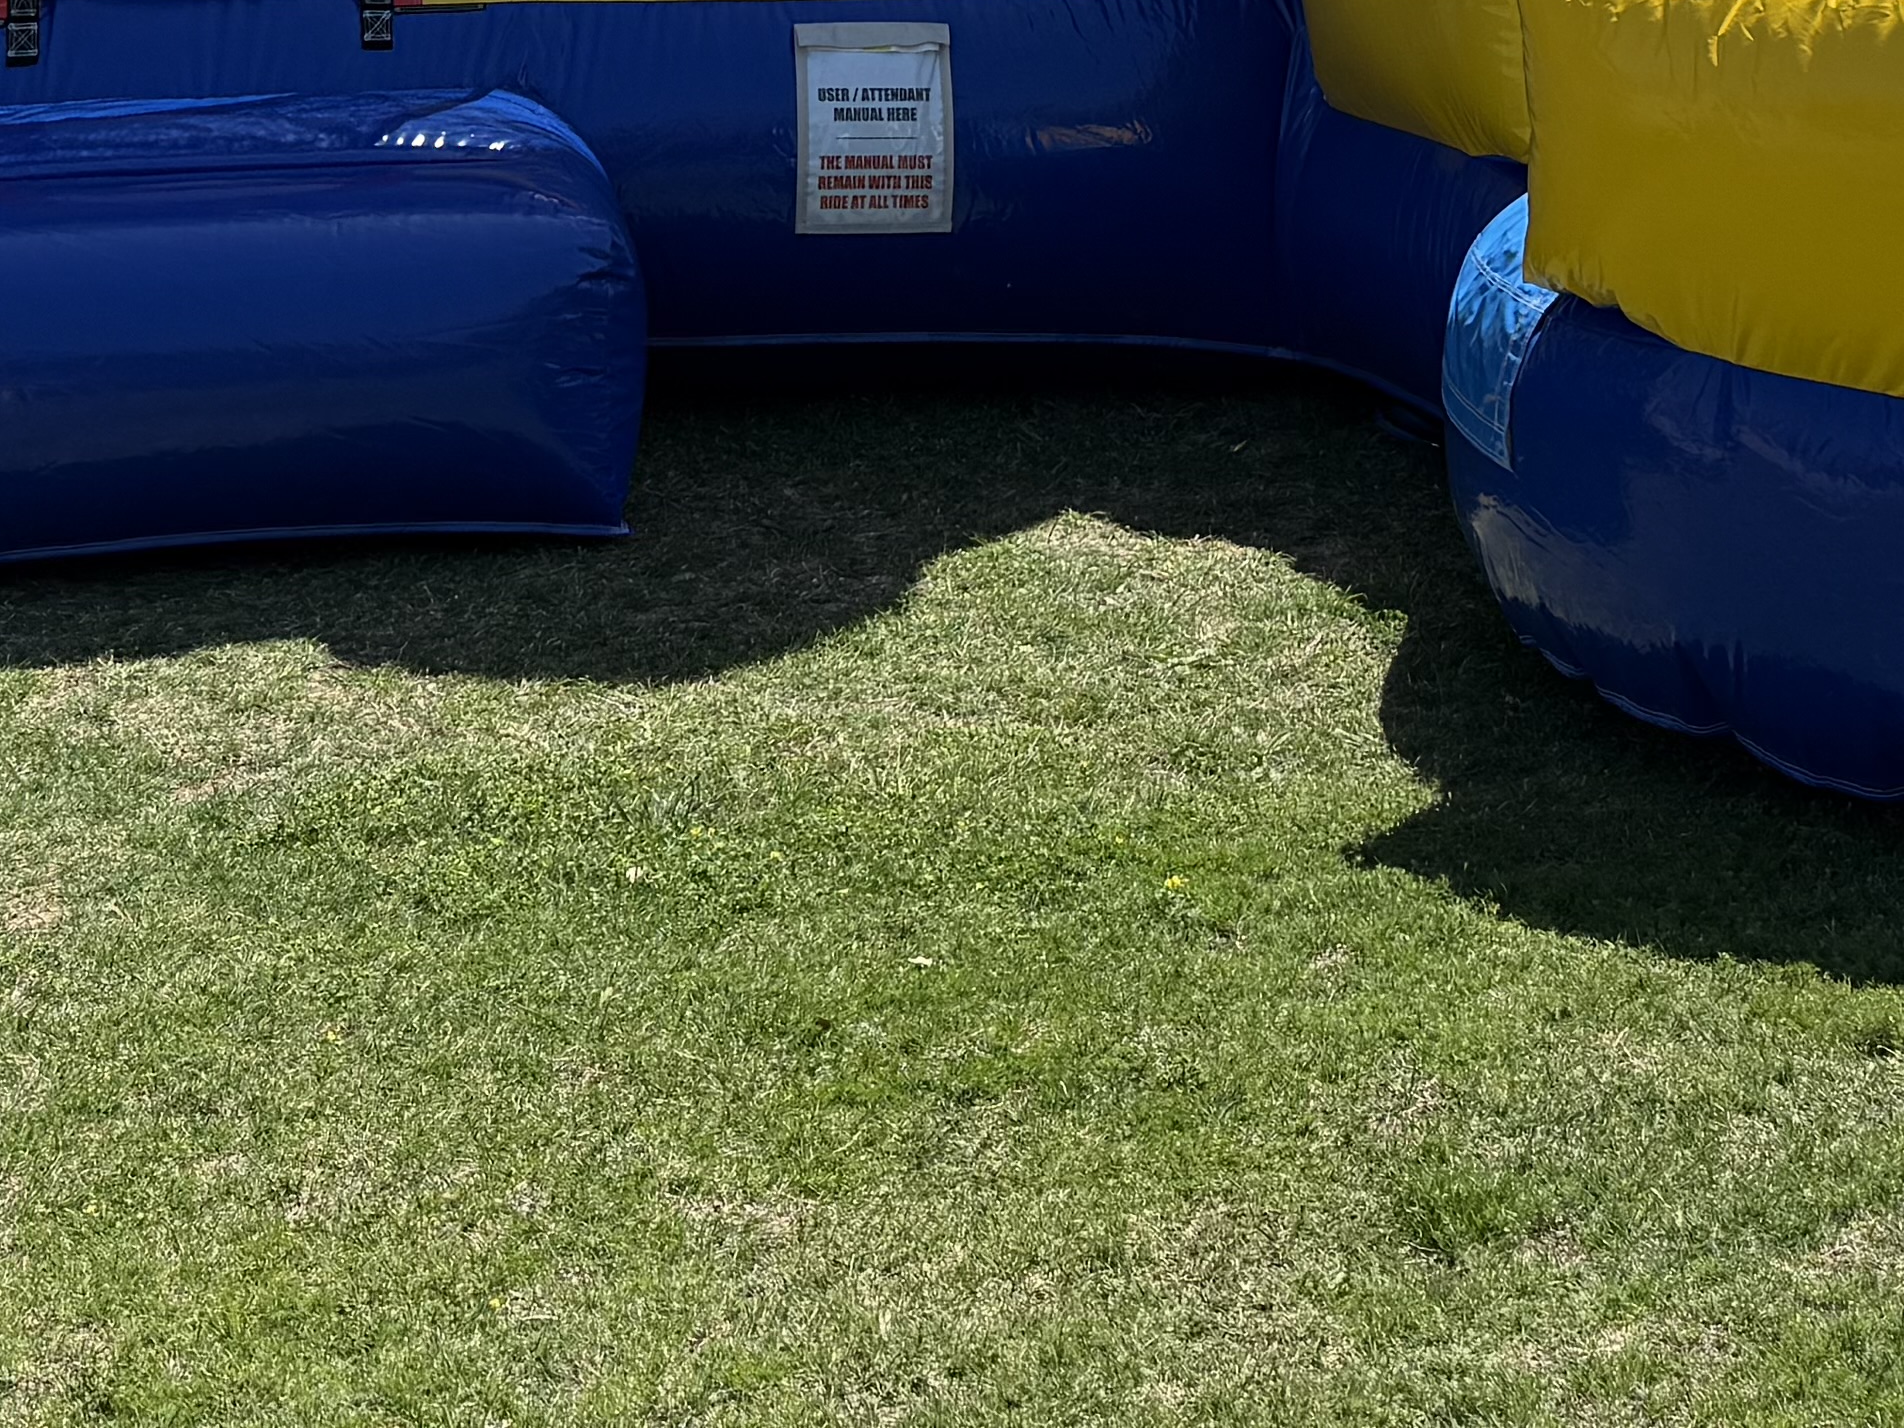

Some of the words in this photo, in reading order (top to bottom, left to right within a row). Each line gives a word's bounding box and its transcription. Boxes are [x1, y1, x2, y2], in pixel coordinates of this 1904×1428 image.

[818, 88, 849, 102] USER
[853, 88, 858, 102] /
[862, 88, 931, 102] ATTENDANT
[834, 108, 884, 121] MANUAL
[887, 108, 917, 121] HERE
[820, 156, 841, 169] THE
[845, 156, 894, 169] MANUAL
[898, 156, 932, 169] MUST
[818, 175, 865, 190] REMAIN
[868, 175, 901, 190] WITH
[904, 175, 932, 190] THIS
[820, 195, 848, 209] RIDE
[851, 195, 866, 209] AT
[869, 195, 888, 209] ALL
[892, 195, 928, 209] TIMES
